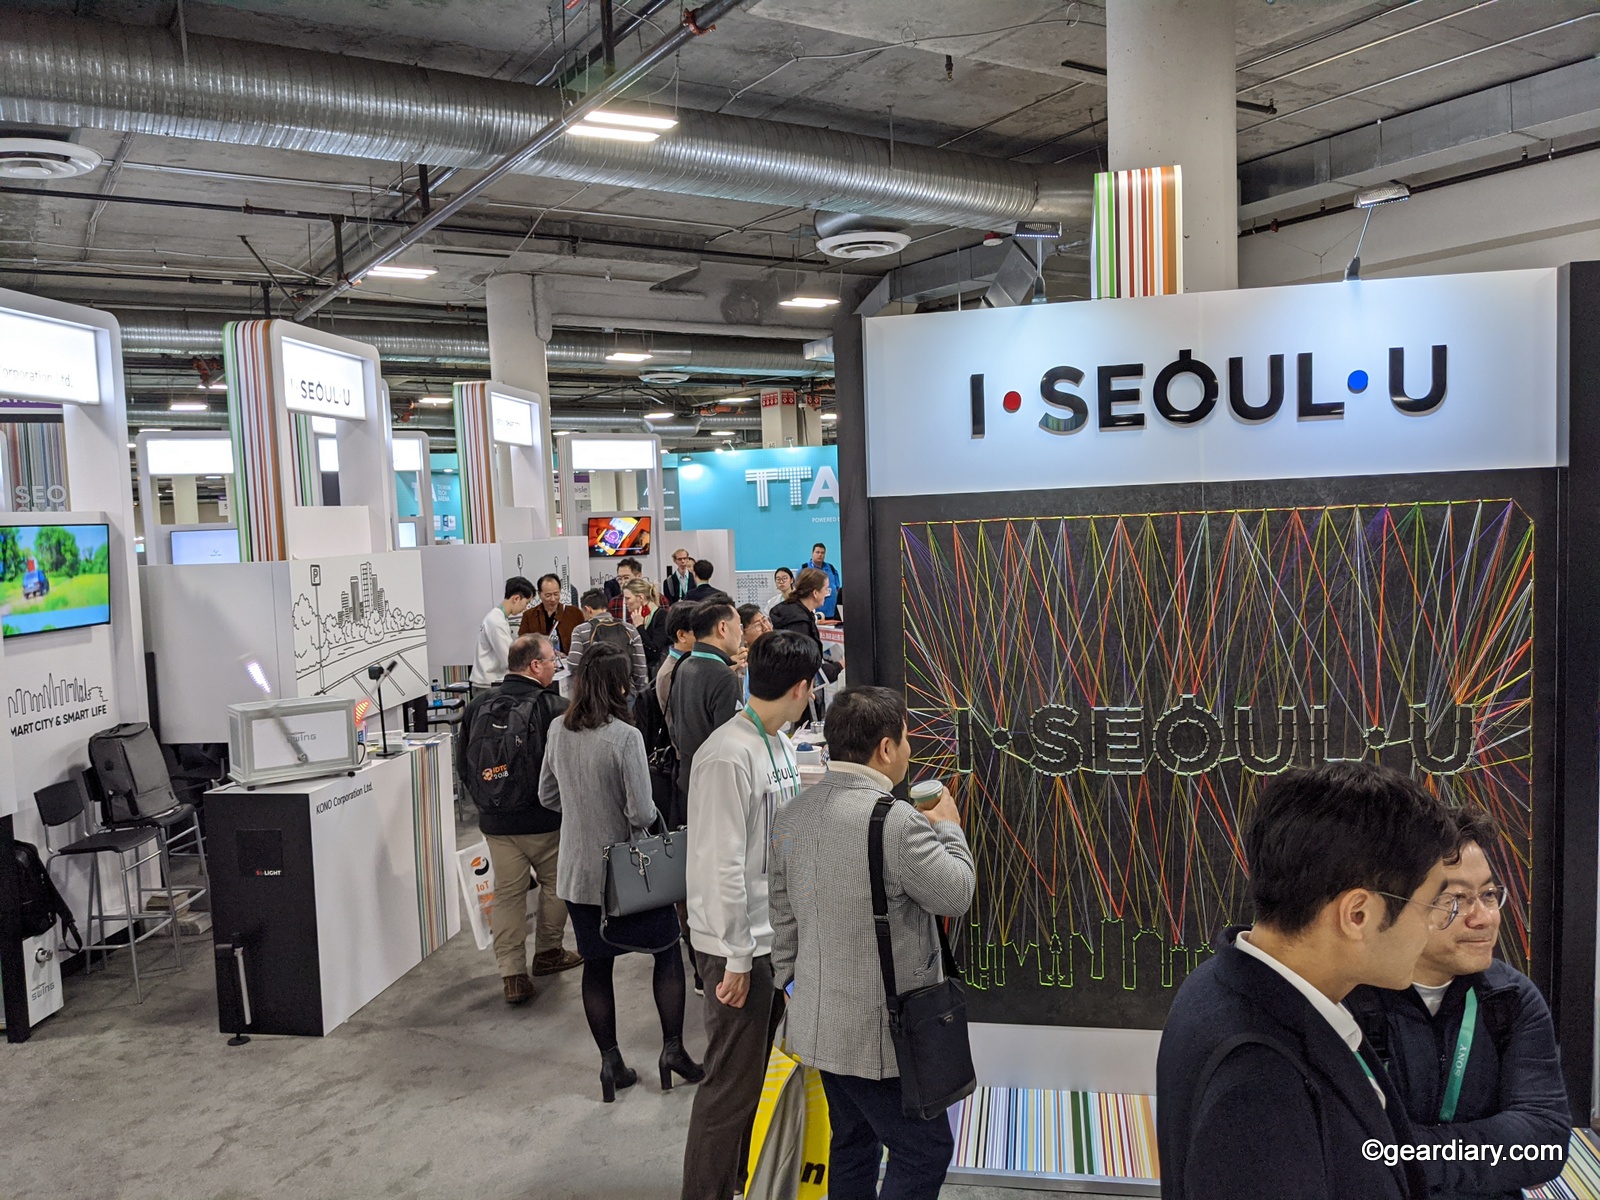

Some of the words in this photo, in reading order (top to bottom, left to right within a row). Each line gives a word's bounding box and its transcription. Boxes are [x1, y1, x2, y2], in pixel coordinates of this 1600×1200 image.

[745, 465, 839, 507] TTA
[10, 722, 34, 737] MART
[34, 717, 54, 731] CITY
[55, 715, 61, 726] &
[63, 709, 89, 724] SMART
[91, 704, 107, 717] LIFE
[493, 770, 509, 780] 2018
[316, 799, 333, 815] KONO
[333, 788, 364, 805] Corporation
[364, 781, 373, 794] Ltd.
[476, 880, 489, 893] IoT
[1454, 1043, 1467, 1077] SONY
